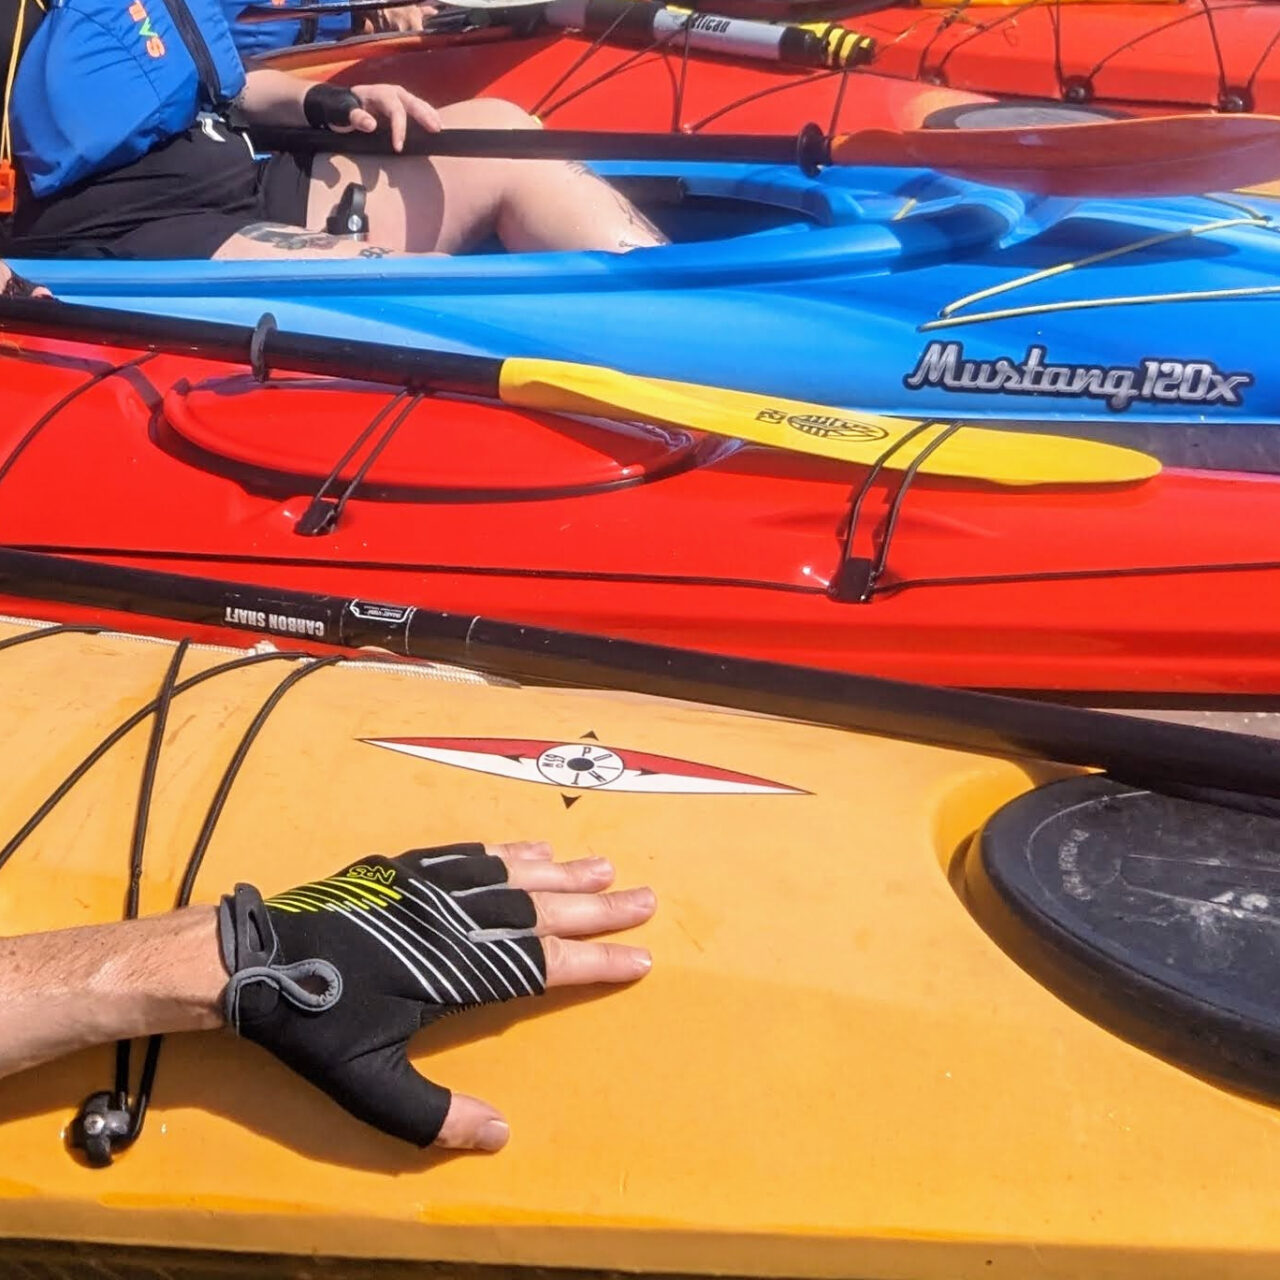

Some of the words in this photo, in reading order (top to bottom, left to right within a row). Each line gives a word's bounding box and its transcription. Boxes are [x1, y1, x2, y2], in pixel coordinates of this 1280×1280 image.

[681, 11, 731, 33] lican
[906, 342, 1141, 410] Mustang
[225, 606, 266, 627] SHAFT
[269, 613, 325, 637] CARBON
